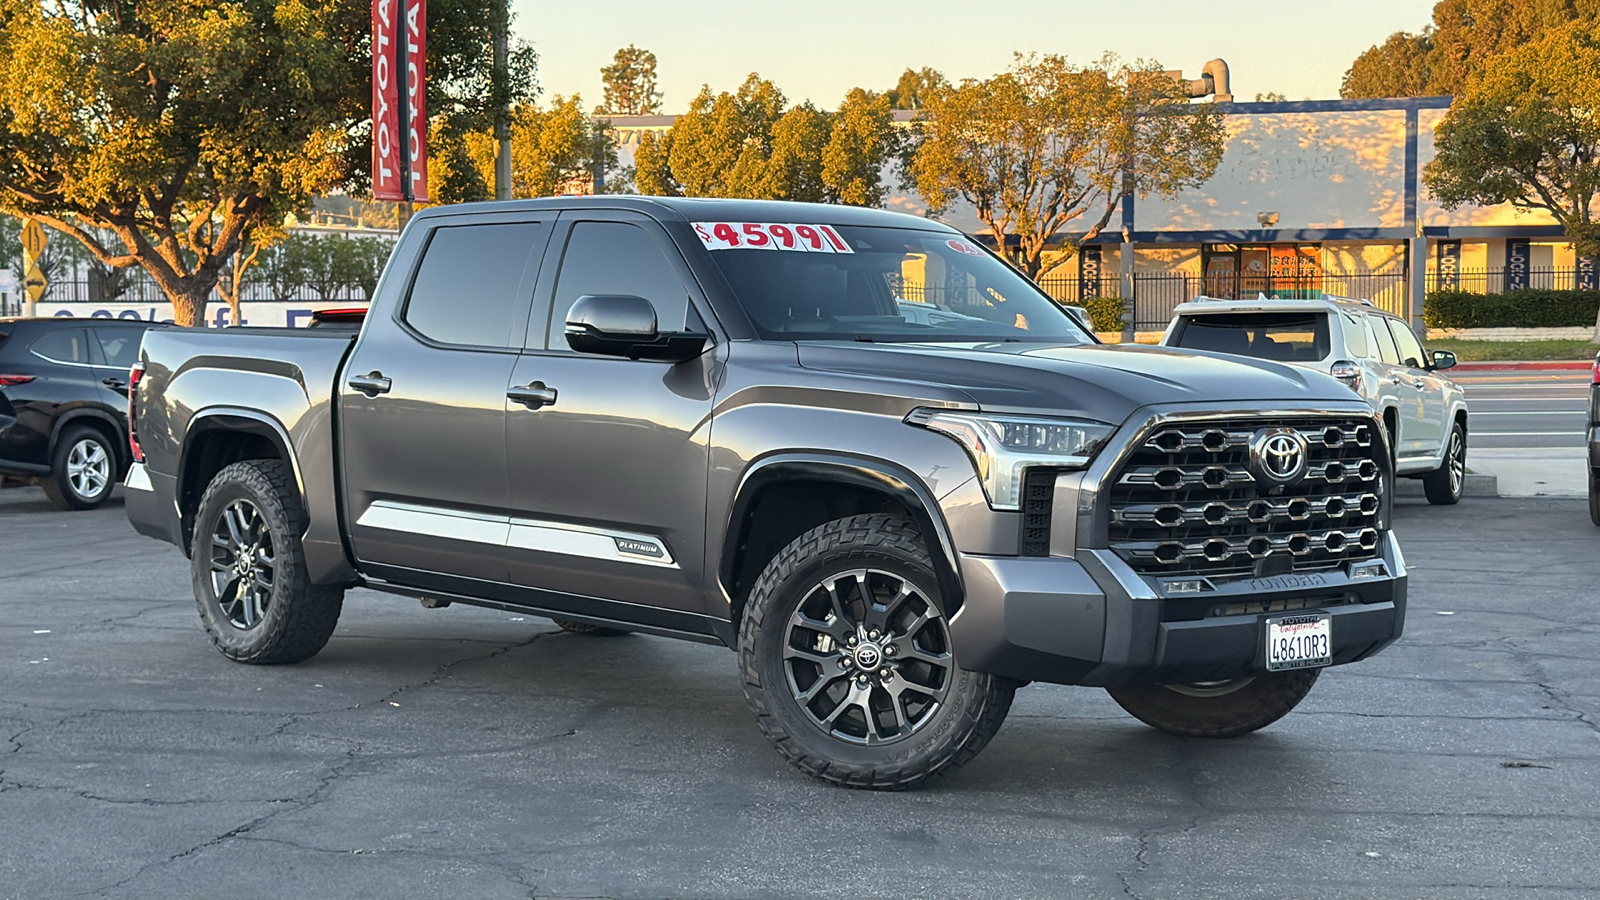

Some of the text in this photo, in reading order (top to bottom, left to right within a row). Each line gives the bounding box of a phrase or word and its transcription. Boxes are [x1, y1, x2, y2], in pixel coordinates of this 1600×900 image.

[377, 0, 392, 187] TOYOTA
[407, 2, 420, 190] TOYOTA
[1083, 250, 1097, 299] FLOORIN
[1442, 243, 1456, 292] FLOORIN
[1510, 242, 1525, 291] FLOORIN
[619, 541, 658, 553] PLATINUM
[1246, 574, 1327, 590] TUNDRA
[1272, 633, 1328, 662] 48610R3
